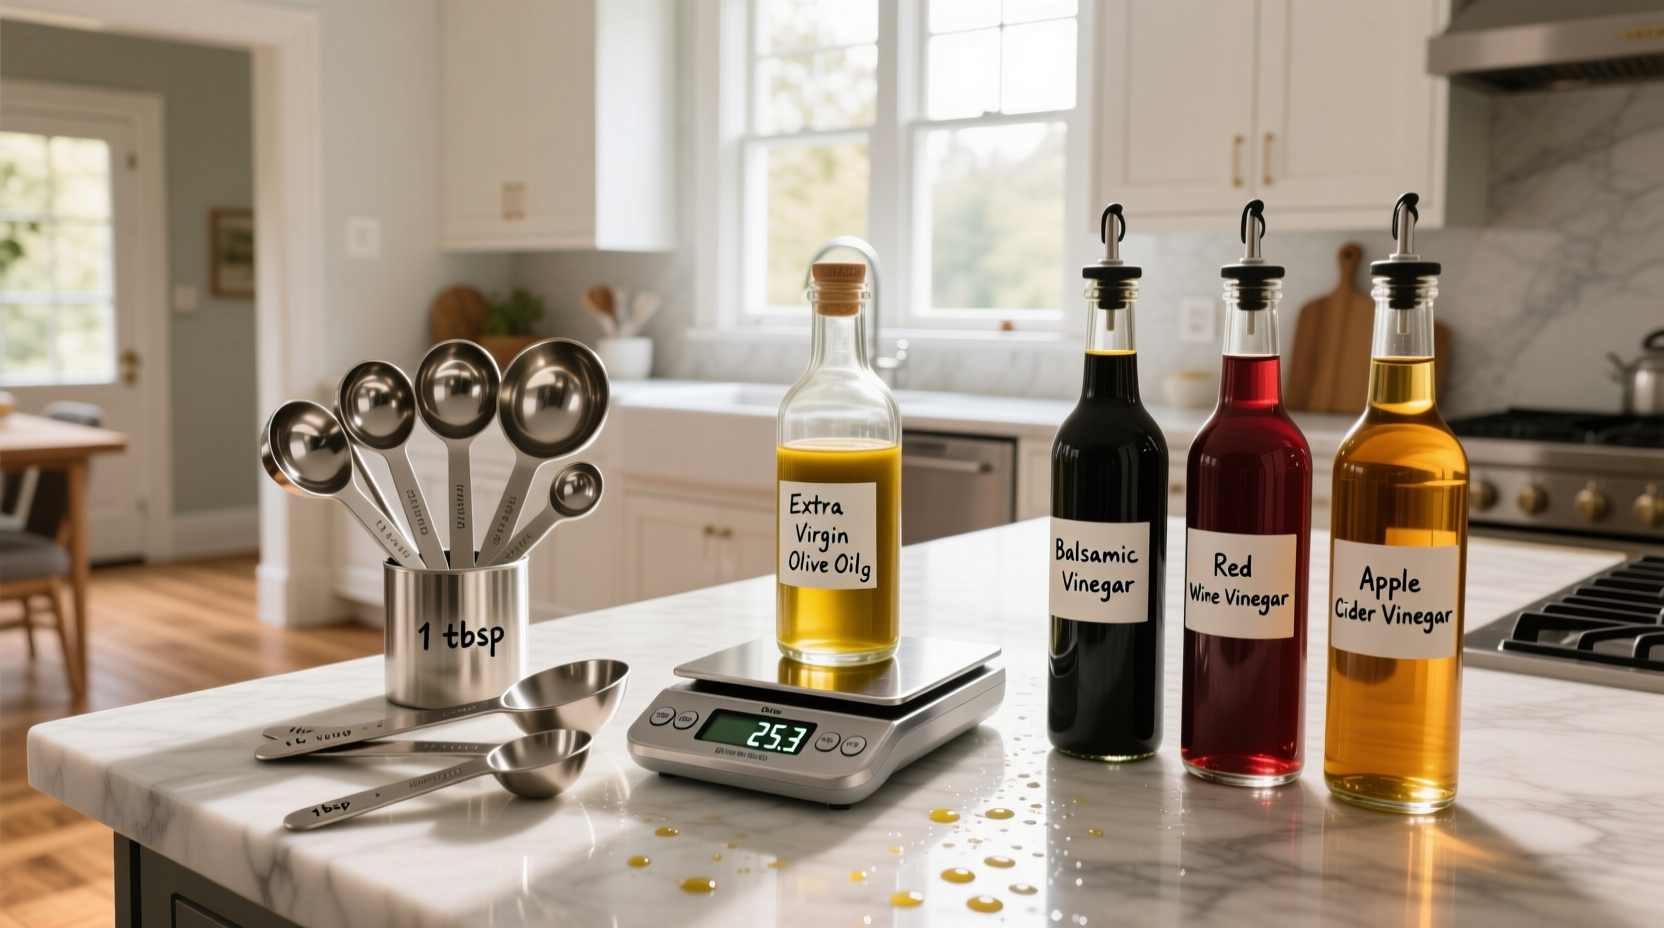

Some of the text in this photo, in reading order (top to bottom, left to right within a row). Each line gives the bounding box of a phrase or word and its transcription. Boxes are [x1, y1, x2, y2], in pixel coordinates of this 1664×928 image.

[789, 493, 844, 515] Extra
[796, 522, 848, 553] Virgin
[1055, 537, 1139, 564] Balsamic
[788, 550, 871, 583] Olive Oilg
[1214, 552, 1252, 577] Red
[1062, 570, 1135, 602] Vinegar
[1189, 582, 1290, 616] Wine Vinegar
[1359, 565, 1421, 601] Apple
[1335, 597, 1453, 634] Cider Vinegar
[418, 620, 505, 657] 1 tbsp
[746, 721, 807, 752] 25.3
